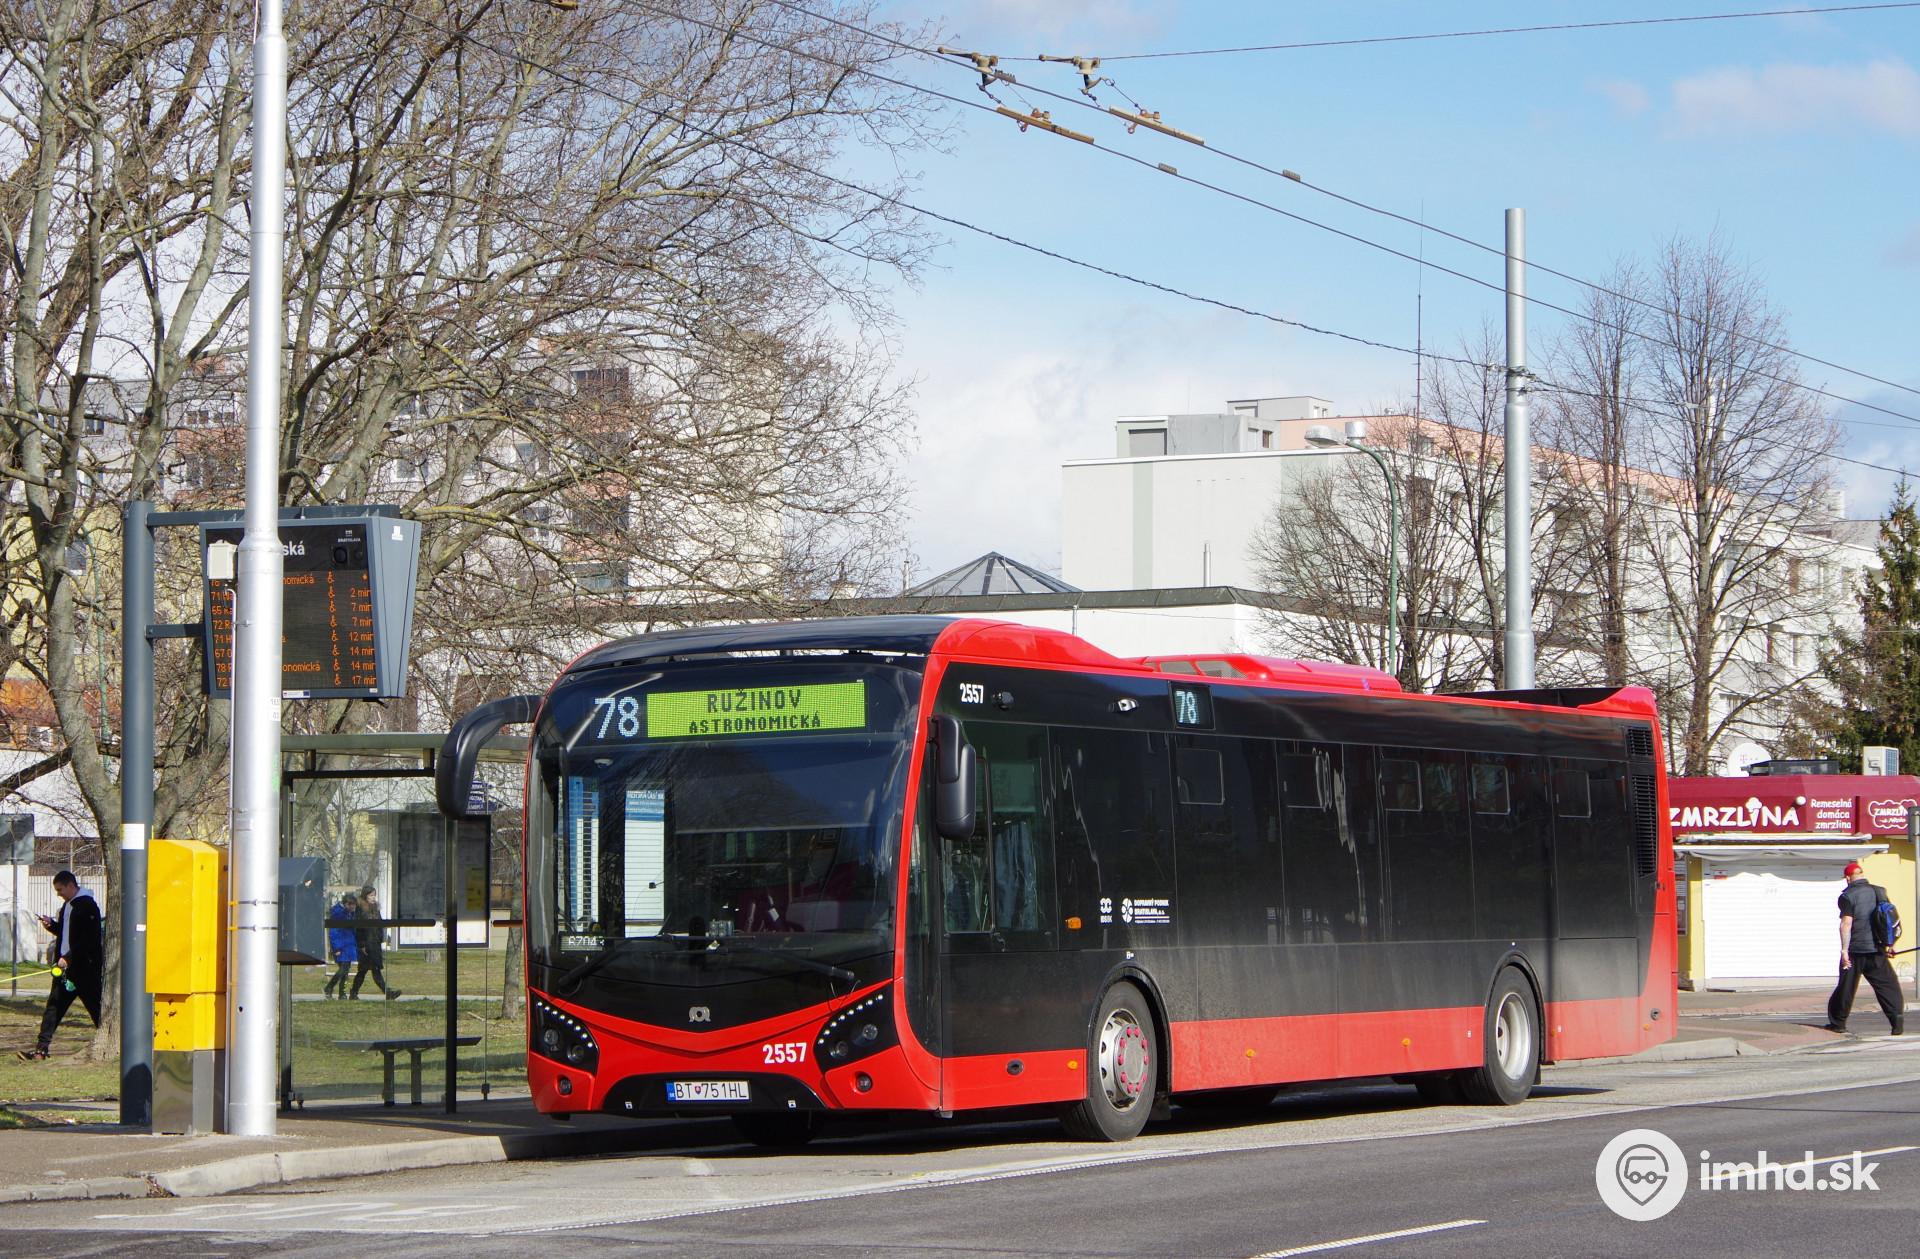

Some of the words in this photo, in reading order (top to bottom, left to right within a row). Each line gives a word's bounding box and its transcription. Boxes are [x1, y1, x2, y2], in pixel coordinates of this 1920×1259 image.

[351, 587, 357, 598] 2
[352, 602, 357, 612] 7
[352, 616, 358, 627] 7
[350, 632, 359, 641] 12
[214, 648, 225, 658] 67
[351, 646, 360, 656] 14
[283, 660, 321, 672] onomická
[351, 661, 361, 670] 14
[217, 677, 228, 687] 72
[353, 675, 362, 685] 17
[959, 683, 984, 704] 2557
[594, 696, 640, 739] 78
[706, 688, 802, 714] RUŽINOV
[1176, 690, 1197, 725] 78
[688, 711, 821, 735] ASTRONOMICKÁ
[1810, 798, 1853, 809] Remeselná
[1669, 798, 1799, 828] ZMRZLINA
[1816, 809, 1851, 819] domáca
[1874, 804, 1908, 816] ZMRZLIN
[1815, 819, 1852, 830] zmrzlina
[762, 1041, 808, 1065] 2557
[675, 1083, 693, 1099] BT
[701, 1083, 748, 1098] 751HL
